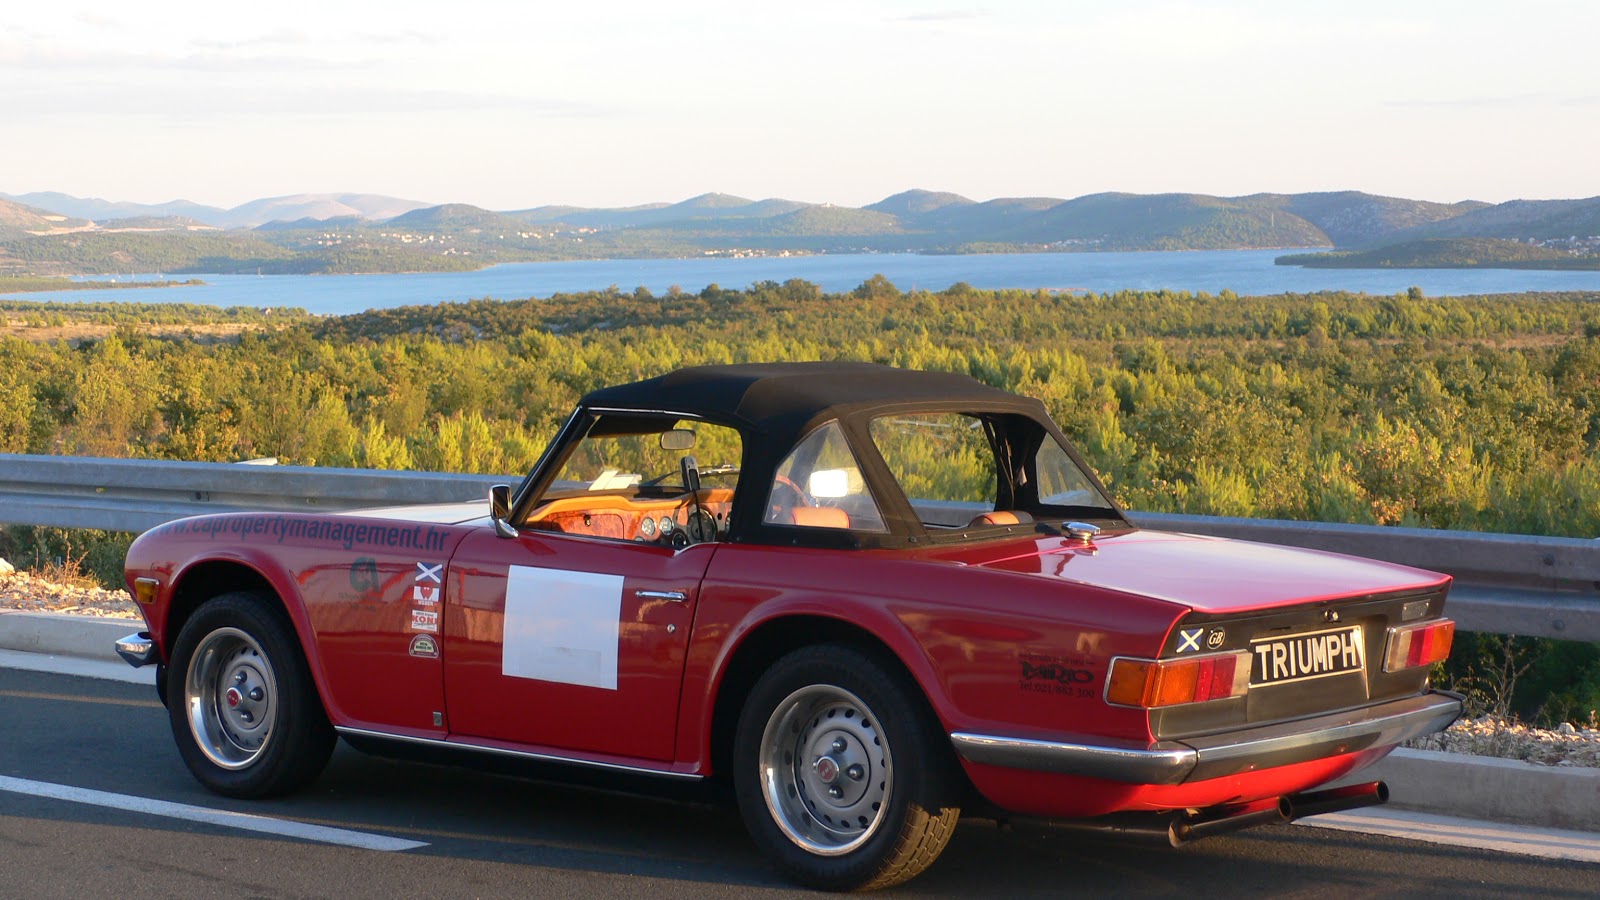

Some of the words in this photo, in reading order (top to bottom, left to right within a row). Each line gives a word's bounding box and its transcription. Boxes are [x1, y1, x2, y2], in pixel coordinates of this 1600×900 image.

[412, 615, 438, 625] KONI
[1208, 631, 1224, 645] GB
[1255, 631, 1357, 681] TRIUMPH
